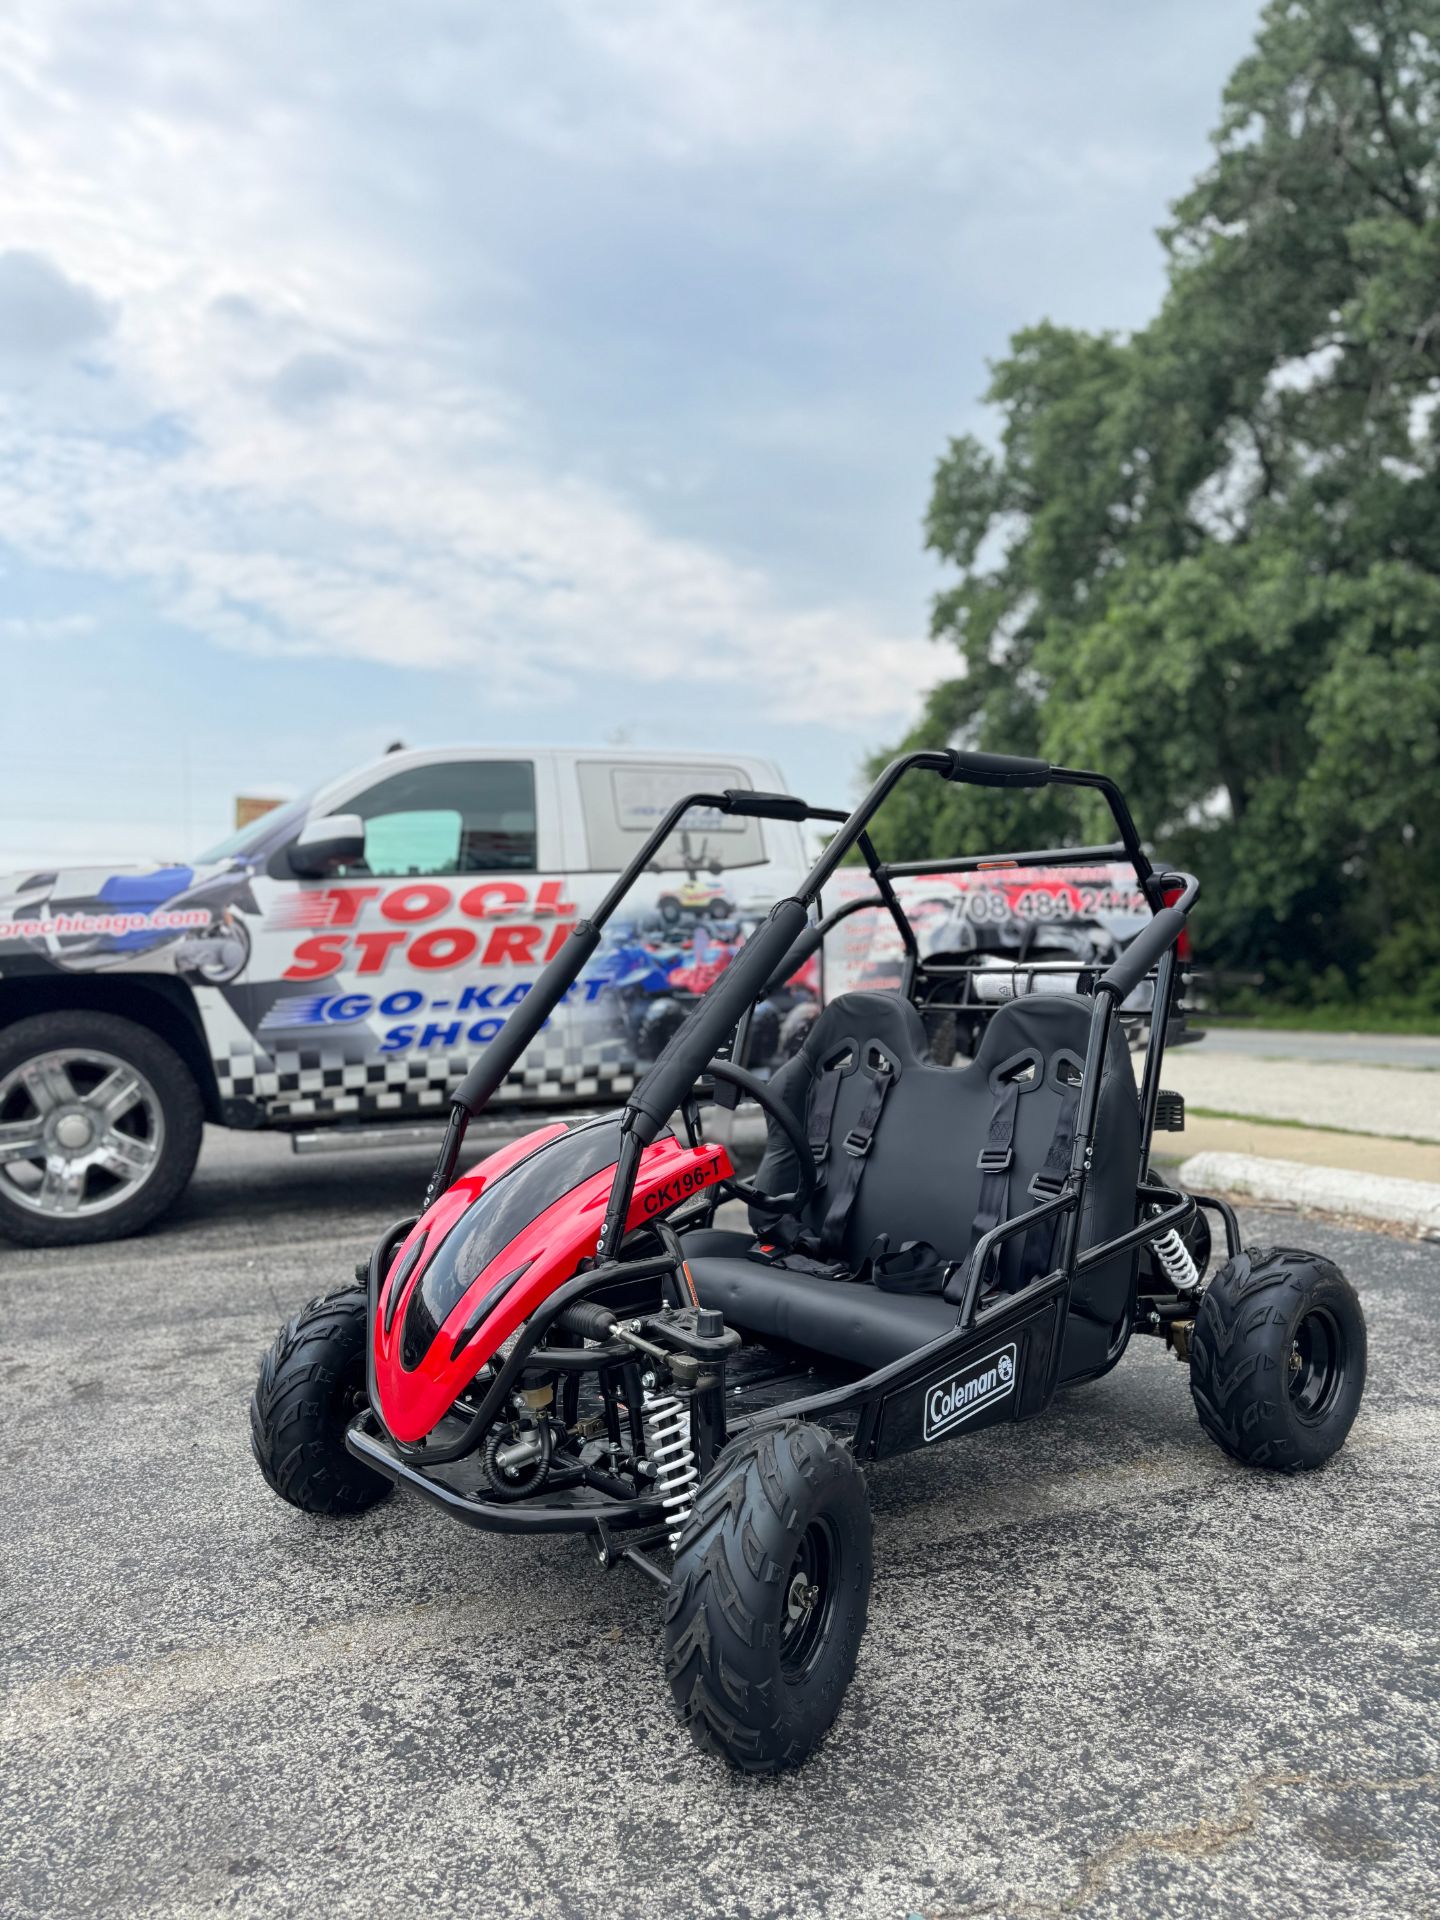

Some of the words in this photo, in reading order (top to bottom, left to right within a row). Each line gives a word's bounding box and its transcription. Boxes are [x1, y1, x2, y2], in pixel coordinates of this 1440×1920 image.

[325, 881, 577, 926] TOOL
[952, 892, 1008, 919] 708
[1018, 889, 1070, 916] 484
[1081, 888, 1147, 914] 2442
[325, 979, 609, 1022] GO-KAT
[378, 1017, 551, 1052] SHO
[643, 1156, 720, 1214] CK196-T
[930, 1368, 997, 1423] Coleman
